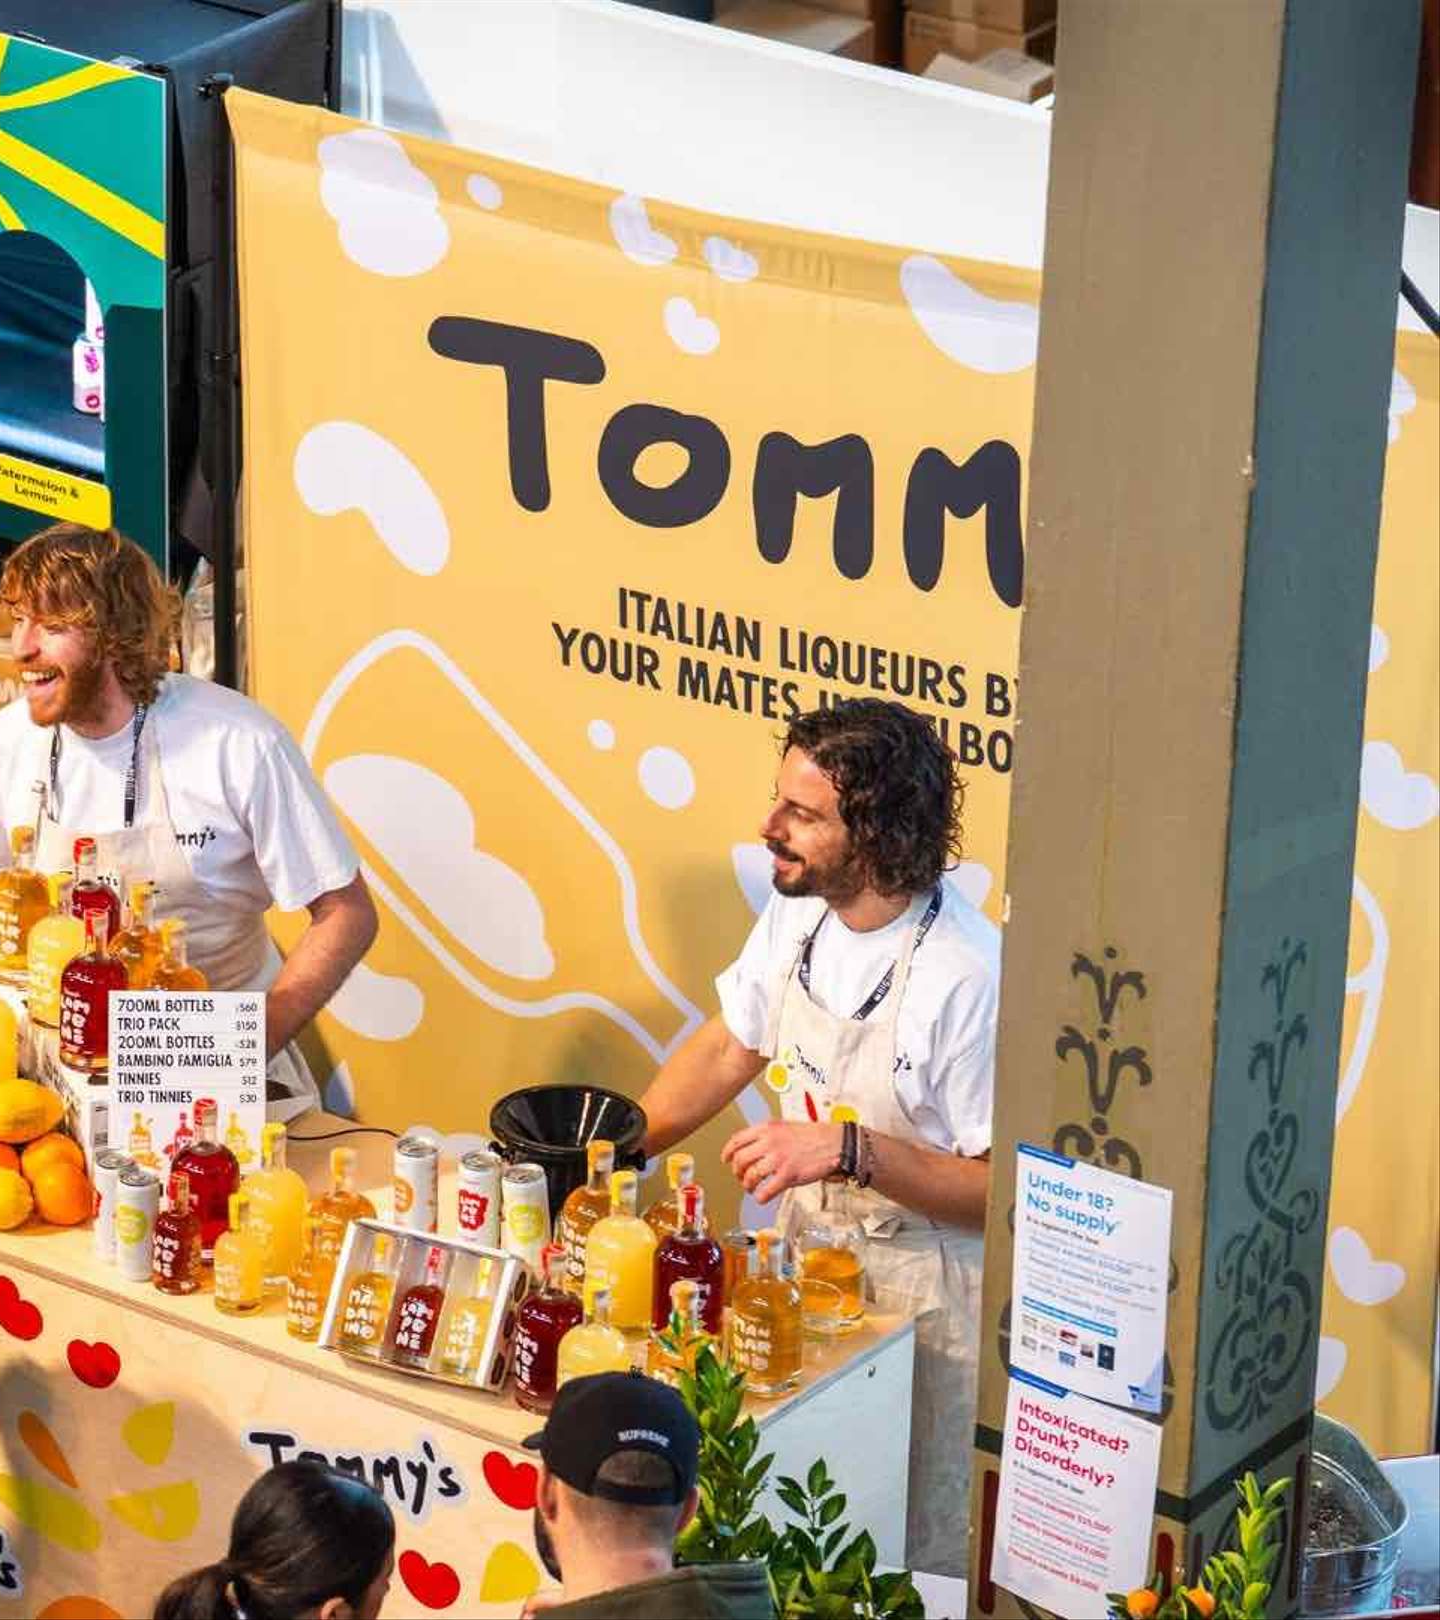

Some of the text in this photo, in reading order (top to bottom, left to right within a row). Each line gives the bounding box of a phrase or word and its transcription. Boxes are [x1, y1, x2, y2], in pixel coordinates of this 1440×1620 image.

[14, 484, 58, 505] Lemon
[70, 487, 79, 499] &
[618, 587, 1020, 718] ITALIAN LIQUEURS B
[551, 622, 662, 690] YOUR
[678, 656, 800, 722] MATES
[117, 999, 162, 1013] 700ML
[165, 999, 215, 1013] BOTTLES
[117, 1017, 145, 1031] TRIO
[148, 1017, 181, 1031] PACK
[117, 1035, 162, 1049] 200ML
[166, 1035, 216, 1049] BOTTLES
[117, 1054, 174, 1068] BAMBINO
[177, 1054, 233, 1068] FAMIGLIA
[117, 1072, 161, 1086] TINNIES
[117, 1090, 145, 1104] TRIO
[149, 1090, 193, 1104] TINNIES
[1027, 1171, 1115, 1213] Under 18?
[1026, 1192, 1117, 1237] No supply
[1017, 1417, 1080, 1453] Drunk?
[1019, 1397, 1129, 1454] Intoxicated?
[1014, 1436, 1115, 1488] Disorderly?
